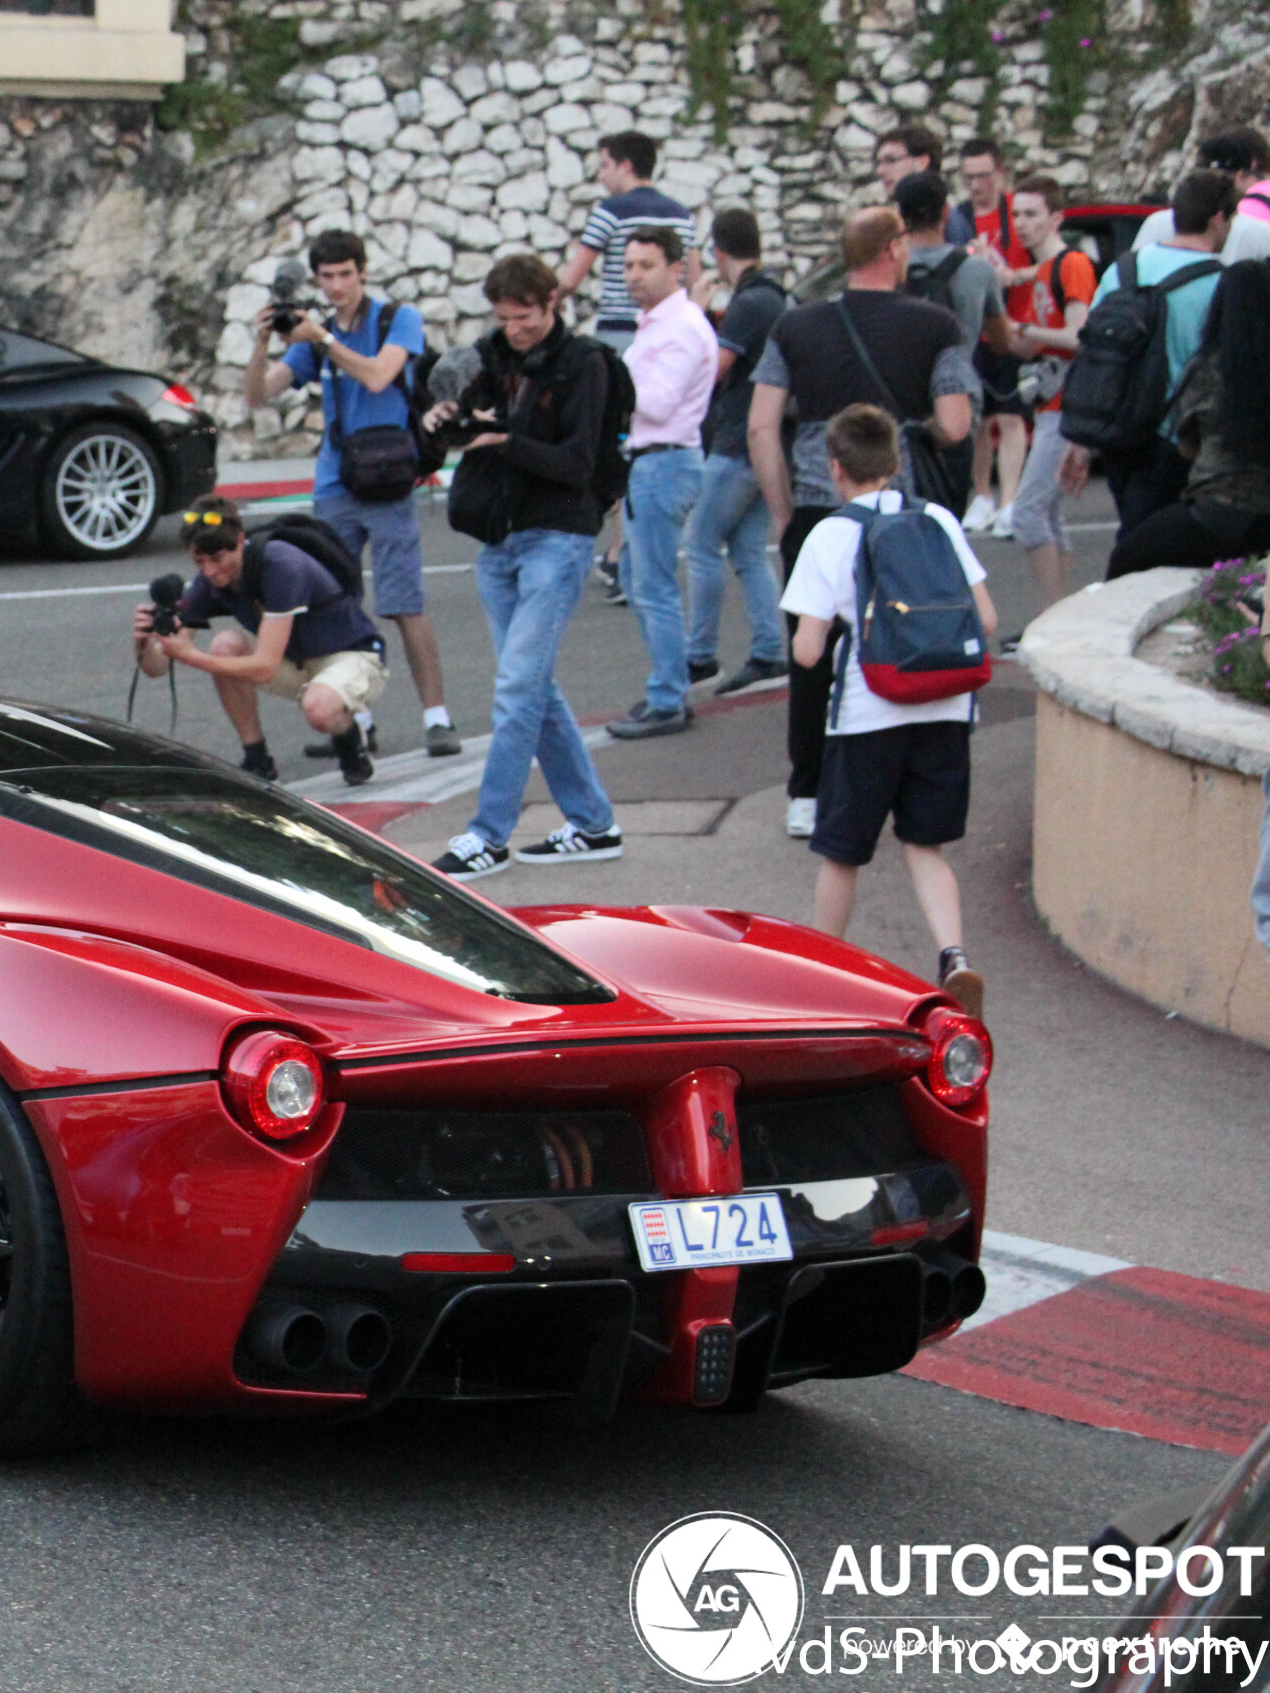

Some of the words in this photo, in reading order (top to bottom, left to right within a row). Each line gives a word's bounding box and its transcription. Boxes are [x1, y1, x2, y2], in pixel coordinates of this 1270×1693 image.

[676, 1202, 777, 1251] L724
[653, 1245, 670, 1261] MC
[735, 1249, 745, 1257] DE
[747, 1247, 776, 1257] MONACO
